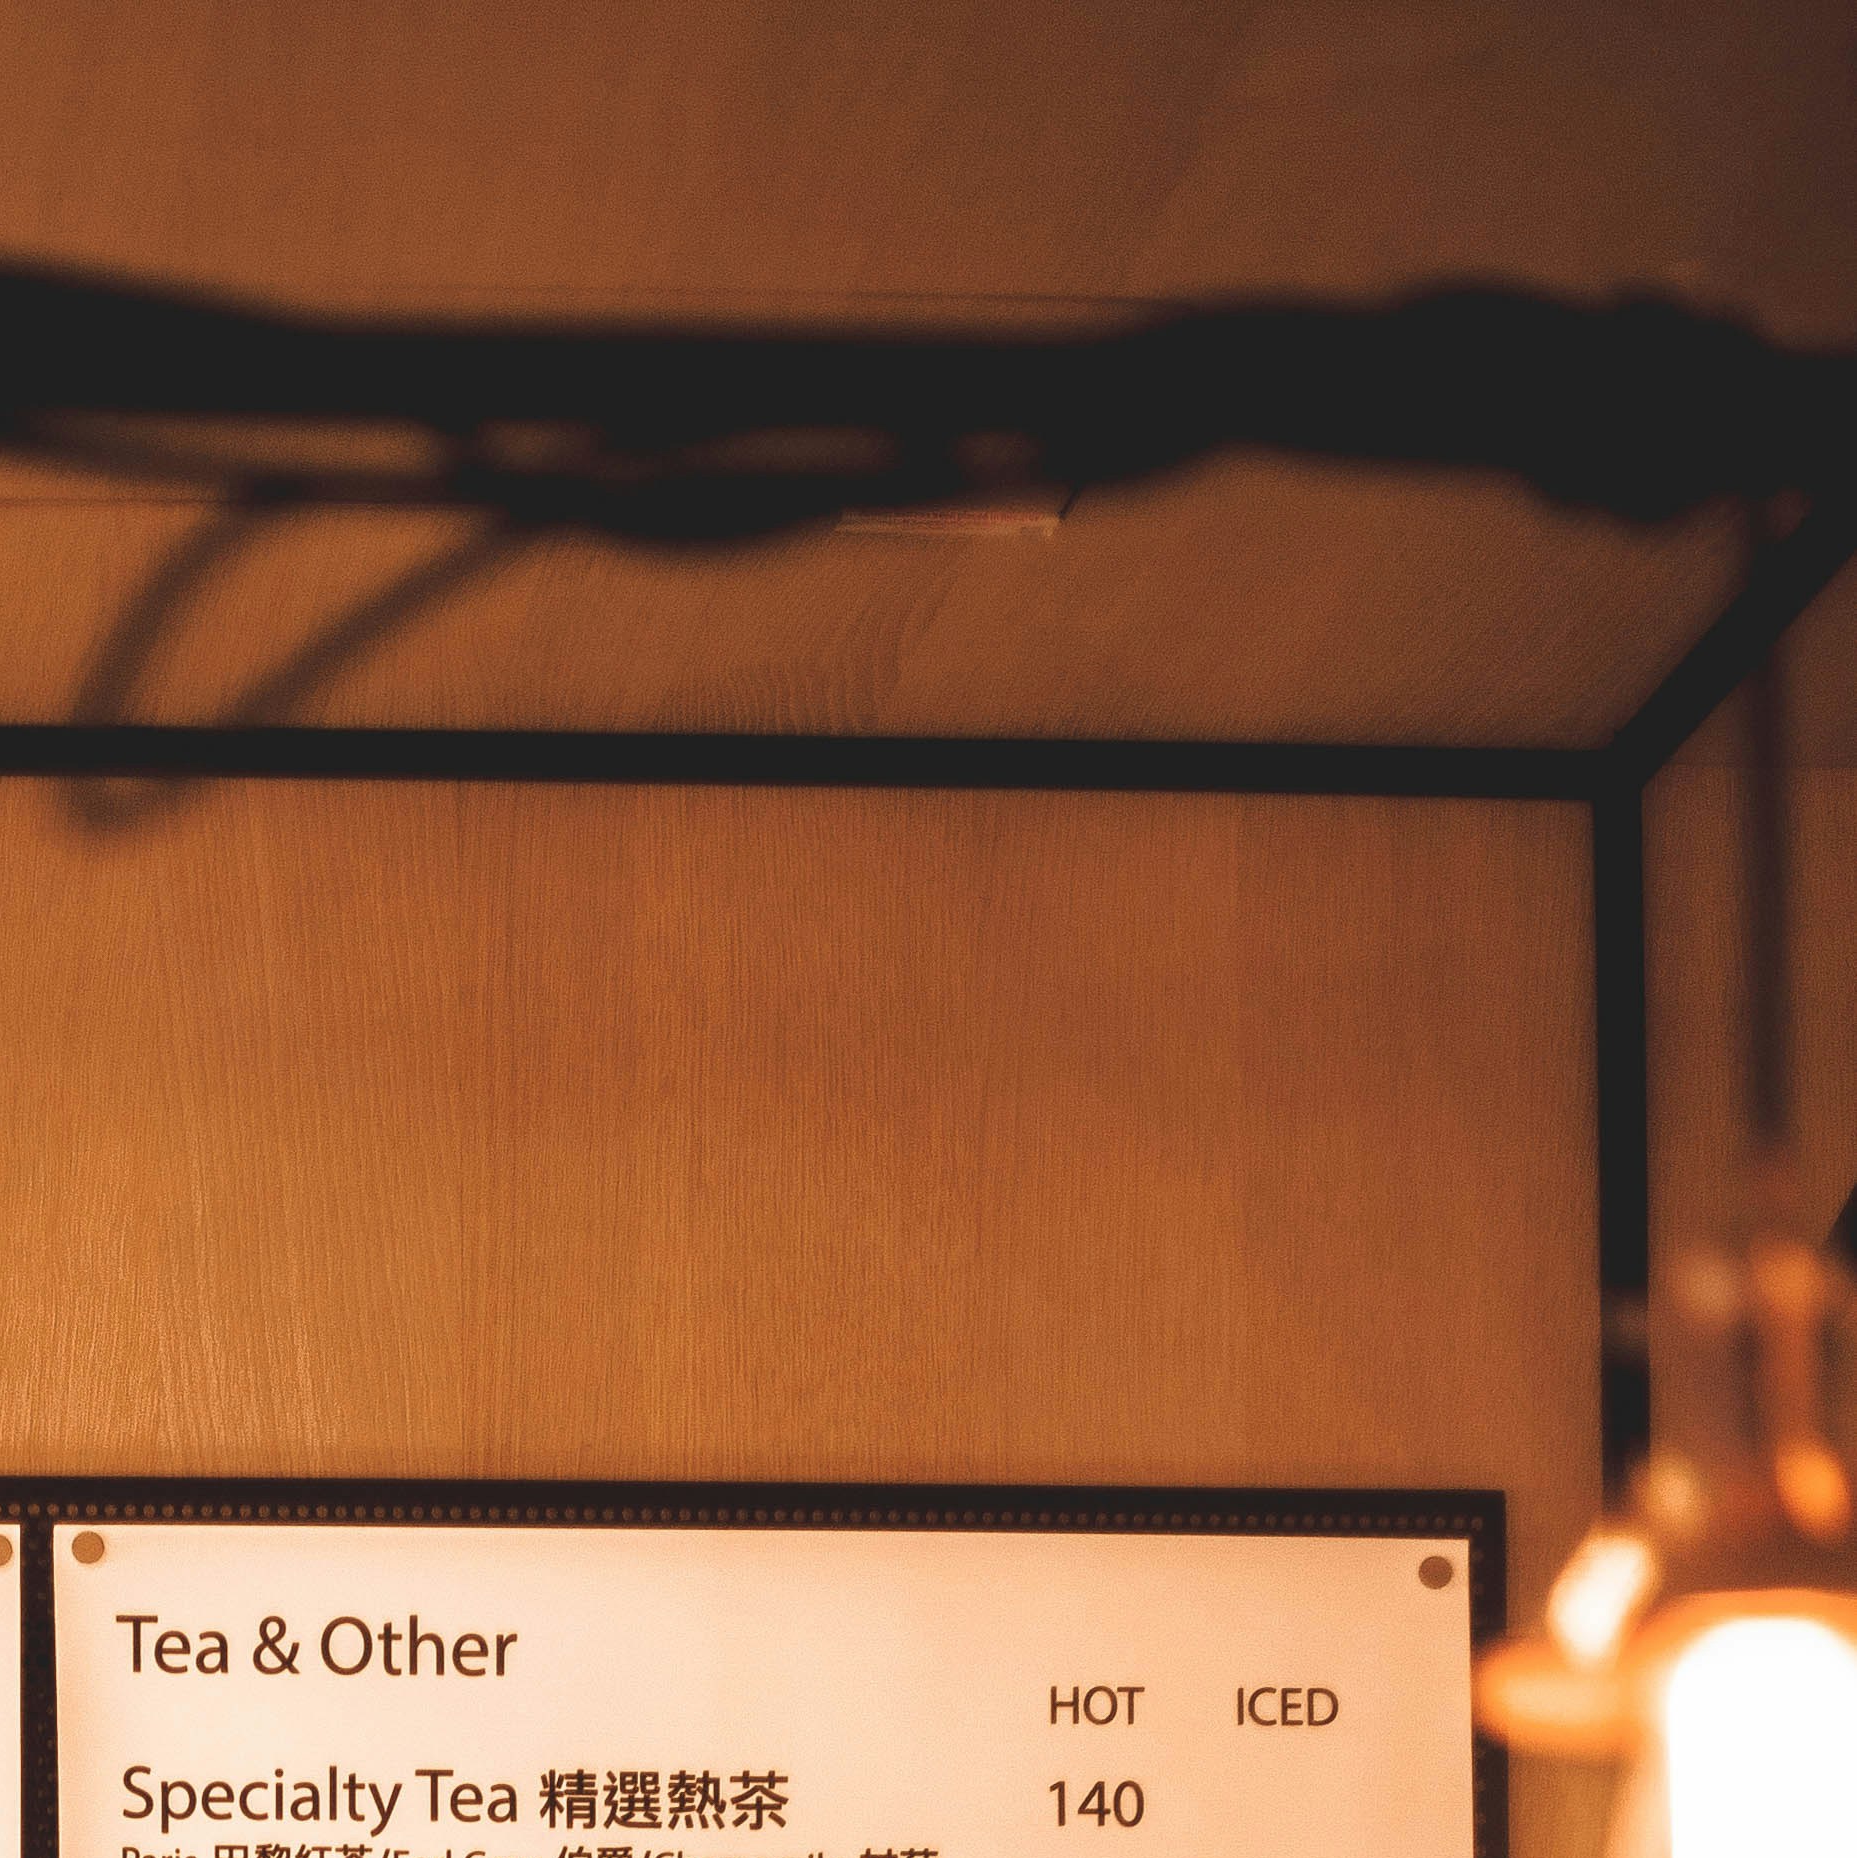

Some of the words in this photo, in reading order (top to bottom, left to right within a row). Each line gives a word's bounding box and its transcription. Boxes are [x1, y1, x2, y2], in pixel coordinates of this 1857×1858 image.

[115, 1614, 229, 1675] Tea
[252, 1615, 301, 1676] &
[320, 1614, 518, 1678] Other
[1050, 1685, 1146, 1726] HOT
[1236, 1686, 1340, 1727] ICED
[122, 1765, 403, 1838] Specialty
[414, 1768, 518, 1824] Tea
[538, 1768, 790, 1831] 精選熱茶
[1049, 1779, 1145, 1828] 140
